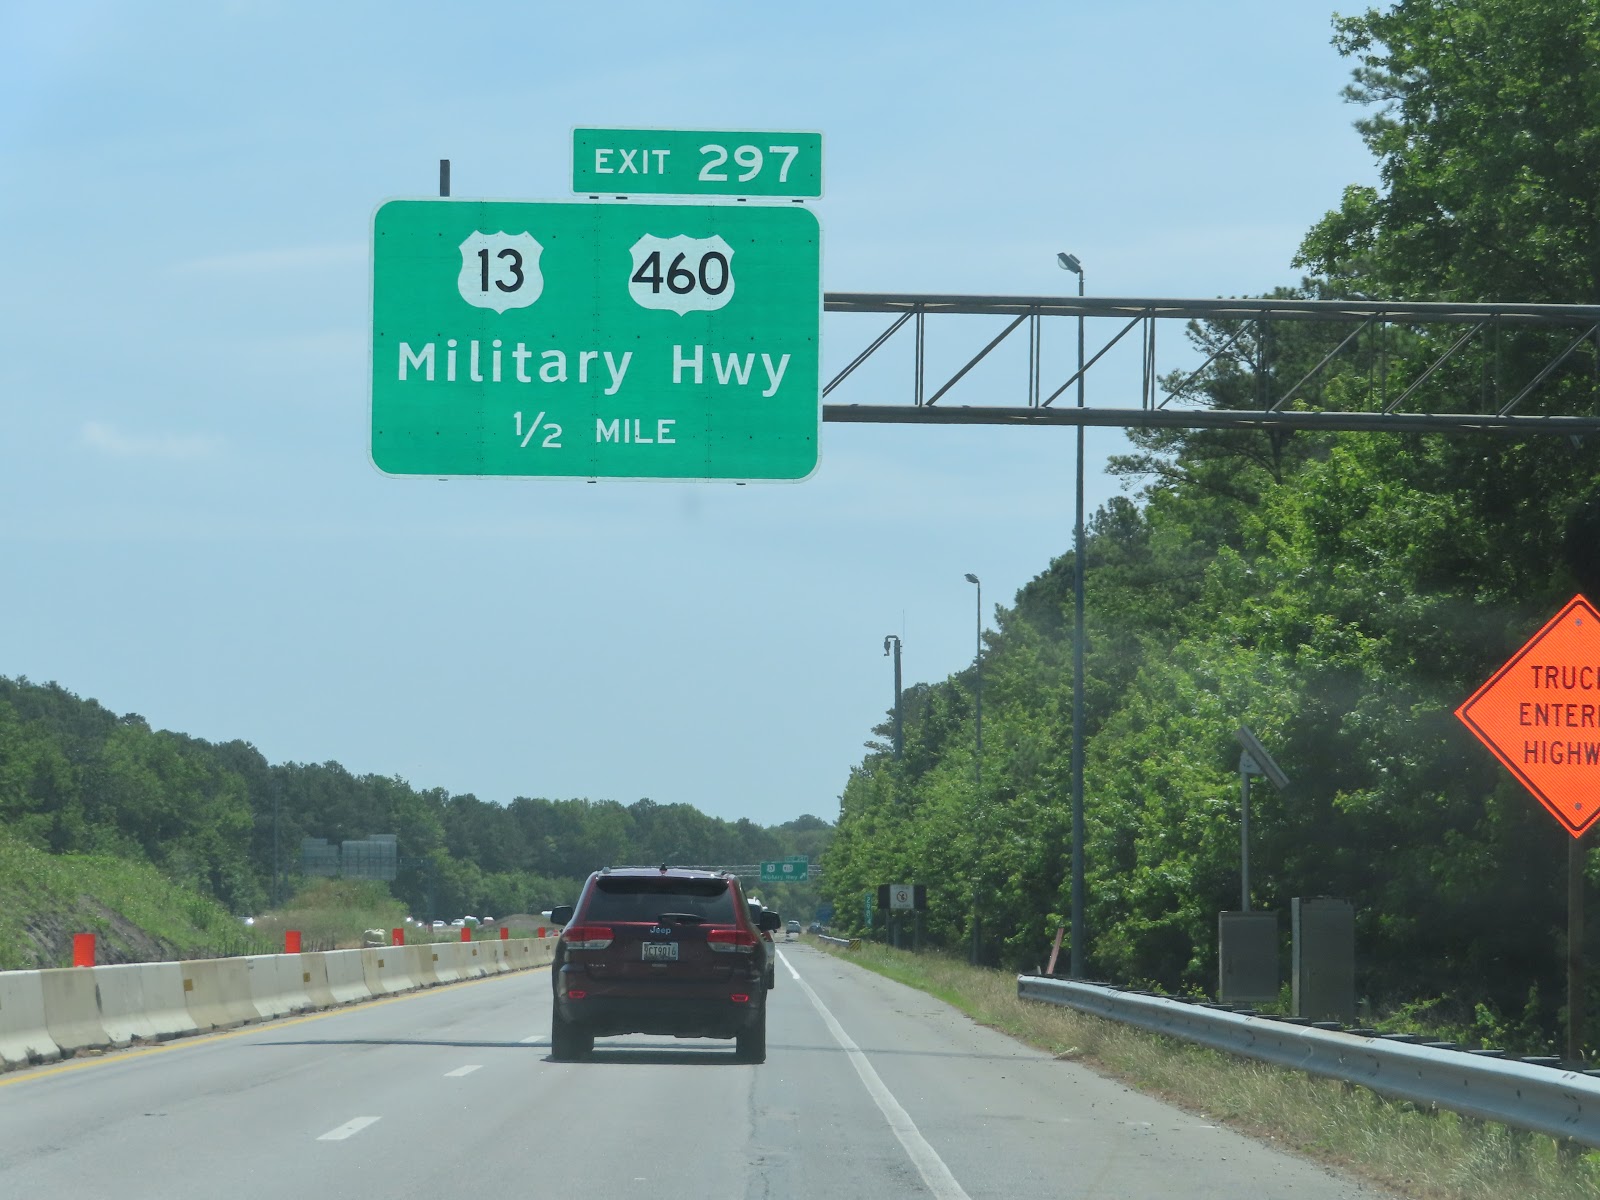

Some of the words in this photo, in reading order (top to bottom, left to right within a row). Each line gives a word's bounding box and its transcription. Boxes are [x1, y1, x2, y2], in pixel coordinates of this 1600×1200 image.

[594, 148, 671, 175] EXIT
[698, 144, 799, 183] 297
[477, 248, 525, 292] 13
[631, 251, 729, 296] 460
[398, 339, 632, 396] Military
[672, 344, 791, 398] Hwy
[596, 418, 676, 444] MILE
[1530, 665, 1600, 690] TRUC
[649, 925, 672, 935] Jeep
